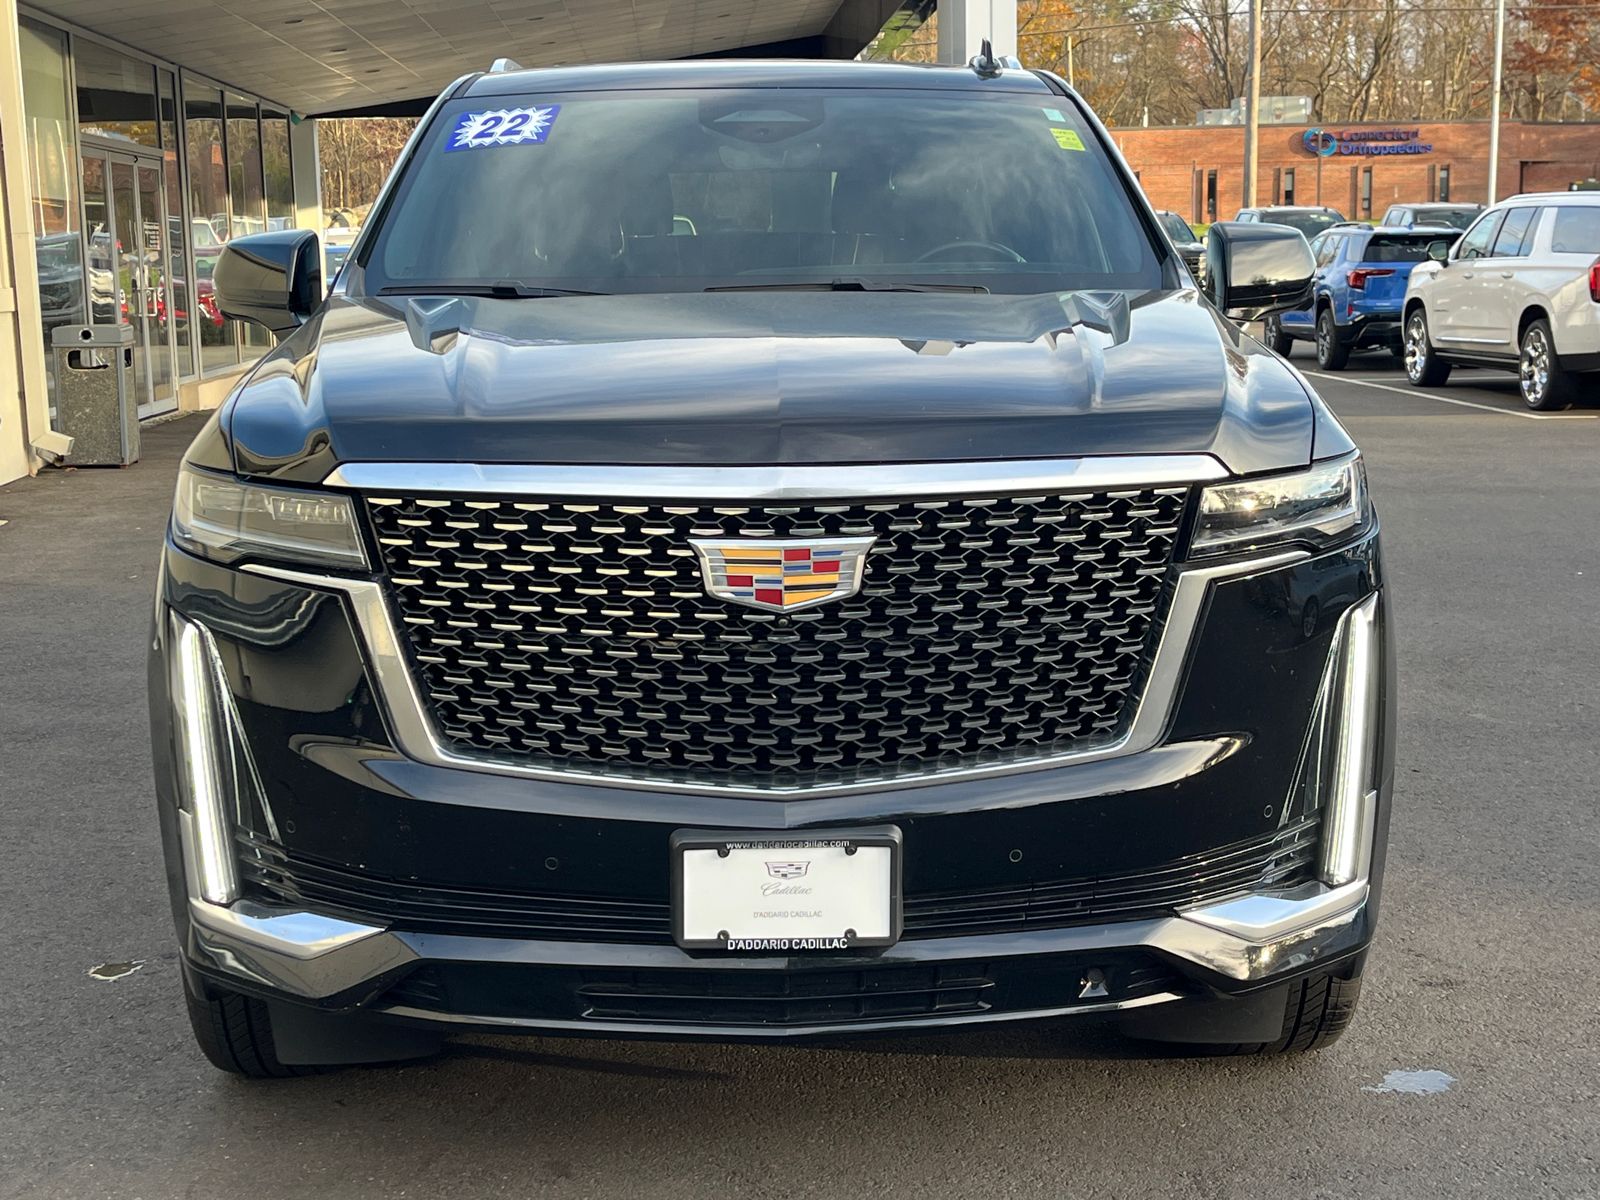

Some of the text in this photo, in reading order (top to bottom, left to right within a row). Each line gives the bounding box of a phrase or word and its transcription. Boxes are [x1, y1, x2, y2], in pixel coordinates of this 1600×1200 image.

[472, 113, 531, 139] 22
[1341, 128, 1419, 141] Connecticut
[1341, 142, 1433, 155] Orthopaedics
[760, 882, 812, 897] Cadillac
[727, 939, 848, 950] D'ADDARIO CADILLAC
